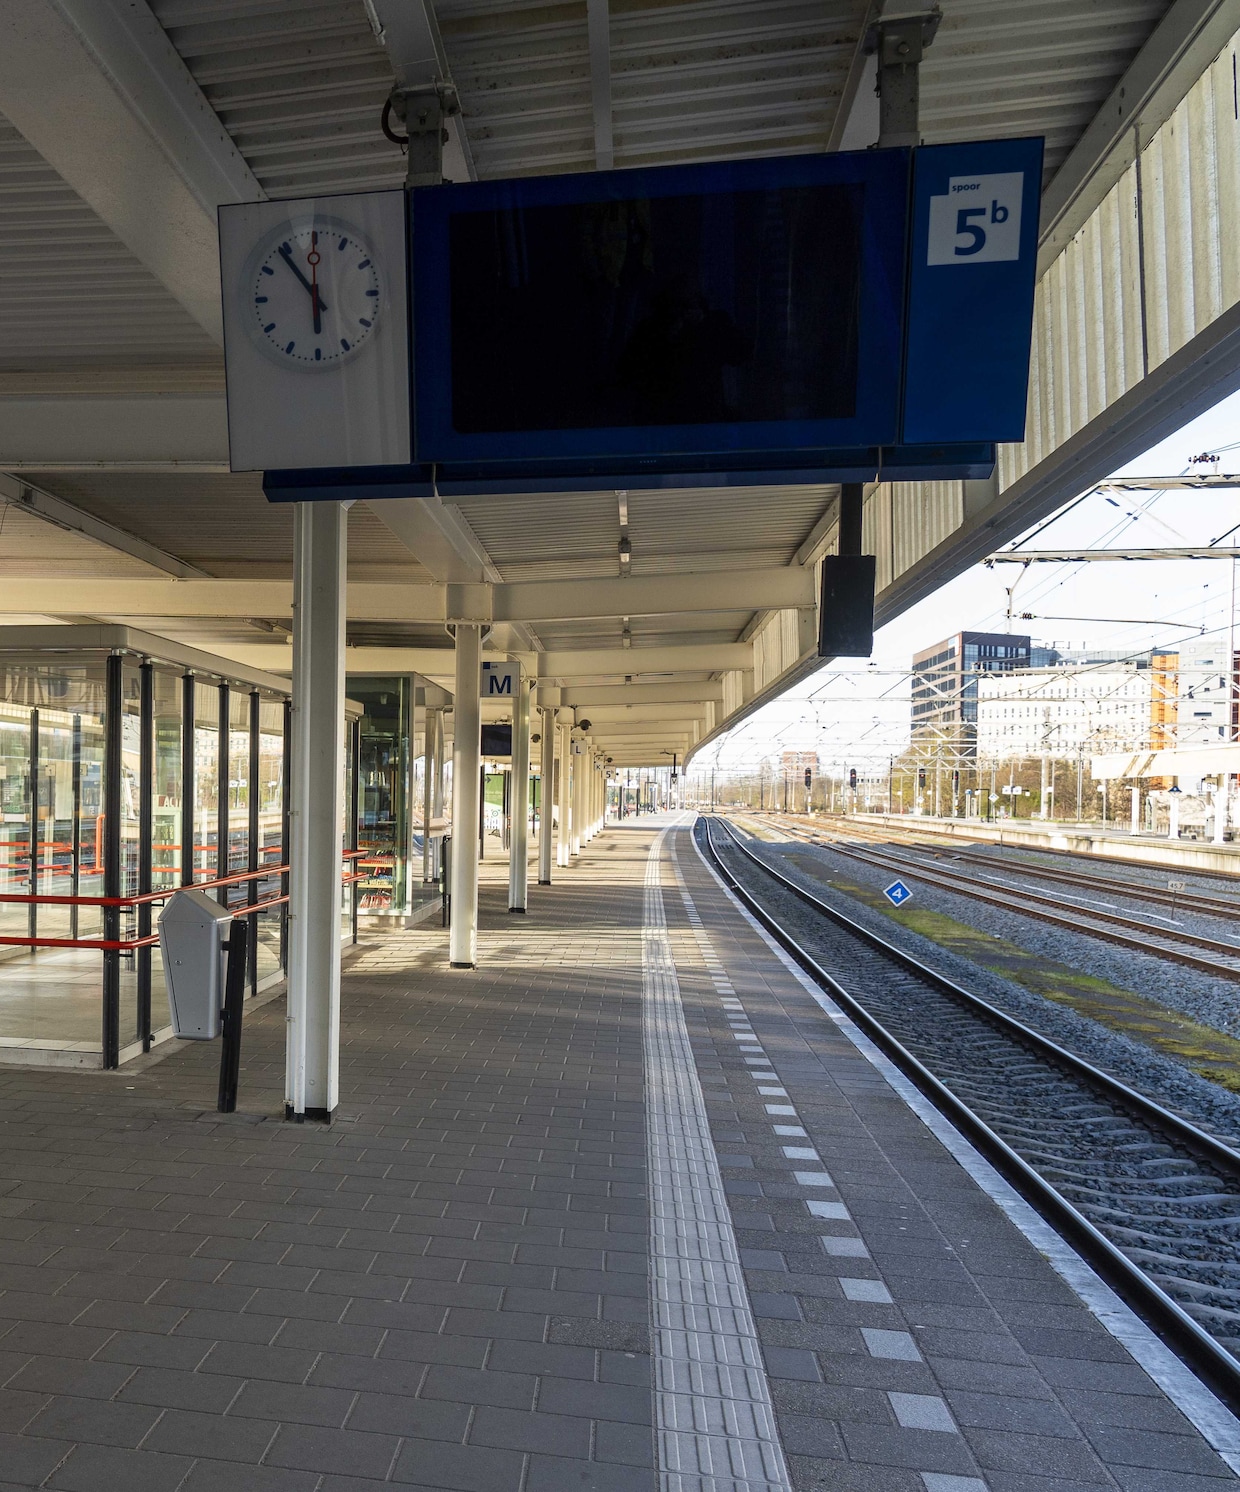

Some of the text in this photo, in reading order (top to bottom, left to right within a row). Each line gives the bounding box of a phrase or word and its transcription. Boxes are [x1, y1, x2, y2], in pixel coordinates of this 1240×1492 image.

[951, 184, 981, 193] spoor
[489, 675, 512, 694] M
[575, 745, 582, 754] L
[891, 887, 903, 899] 4
